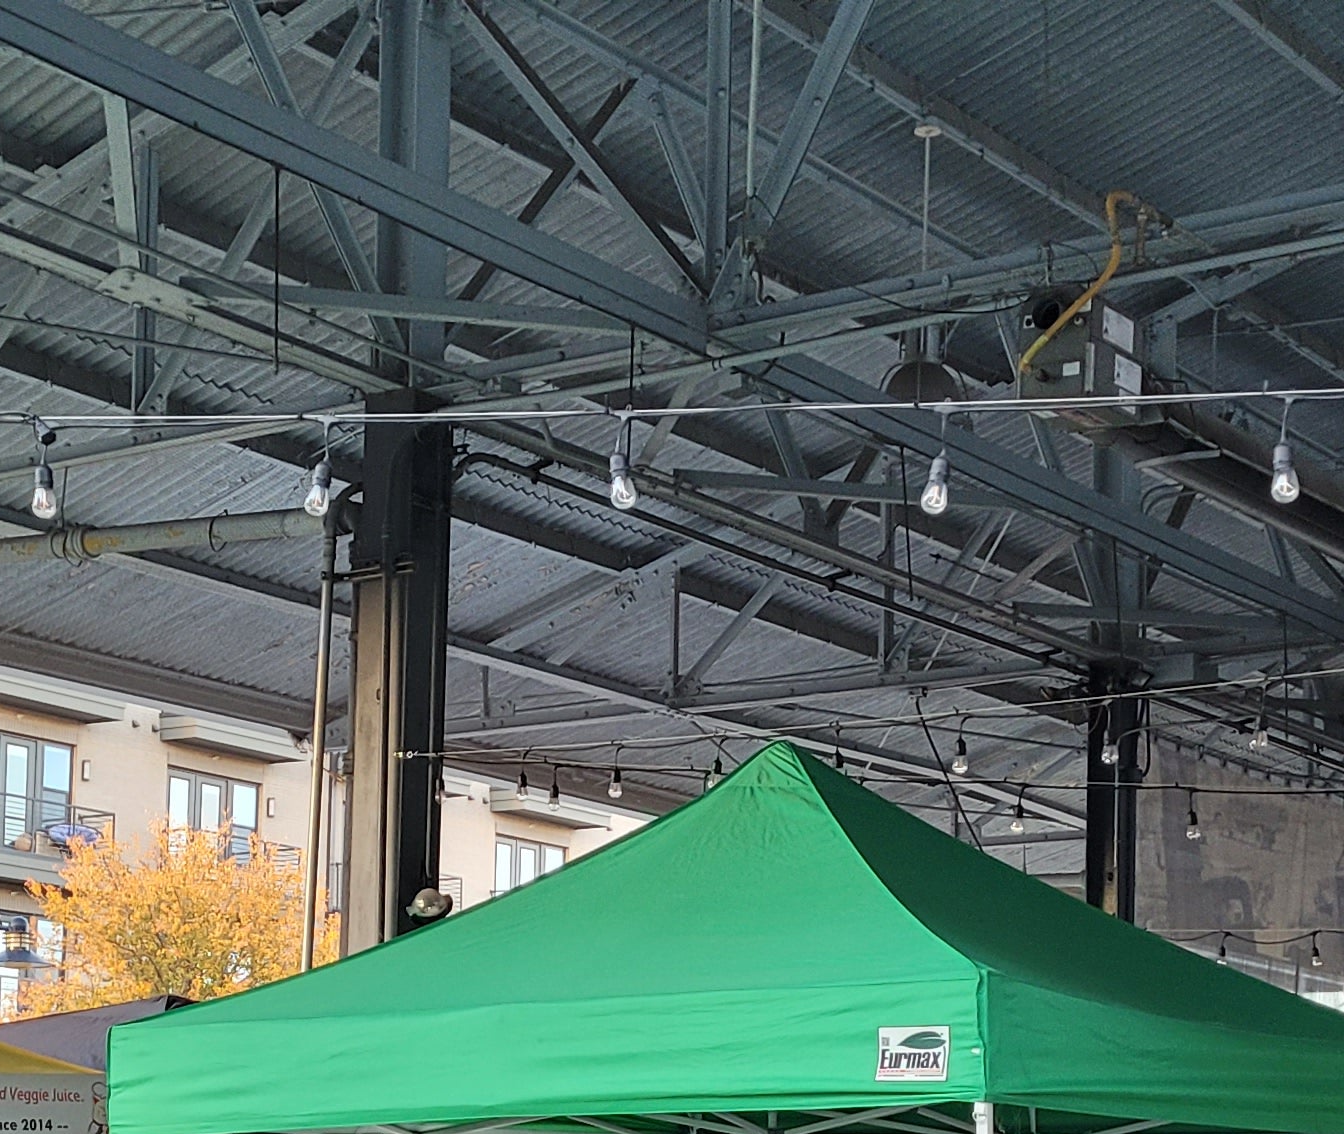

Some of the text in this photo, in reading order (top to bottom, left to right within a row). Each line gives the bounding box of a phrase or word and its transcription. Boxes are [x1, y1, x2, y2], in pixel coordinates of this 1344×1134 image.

[879, 1049, 941, 1070] Eurmax
[9, 1087, 49, 1105] Veggie
[51, 1088, 85, 1103] Juice.
[21, 1118, 53, 1131] 2014
